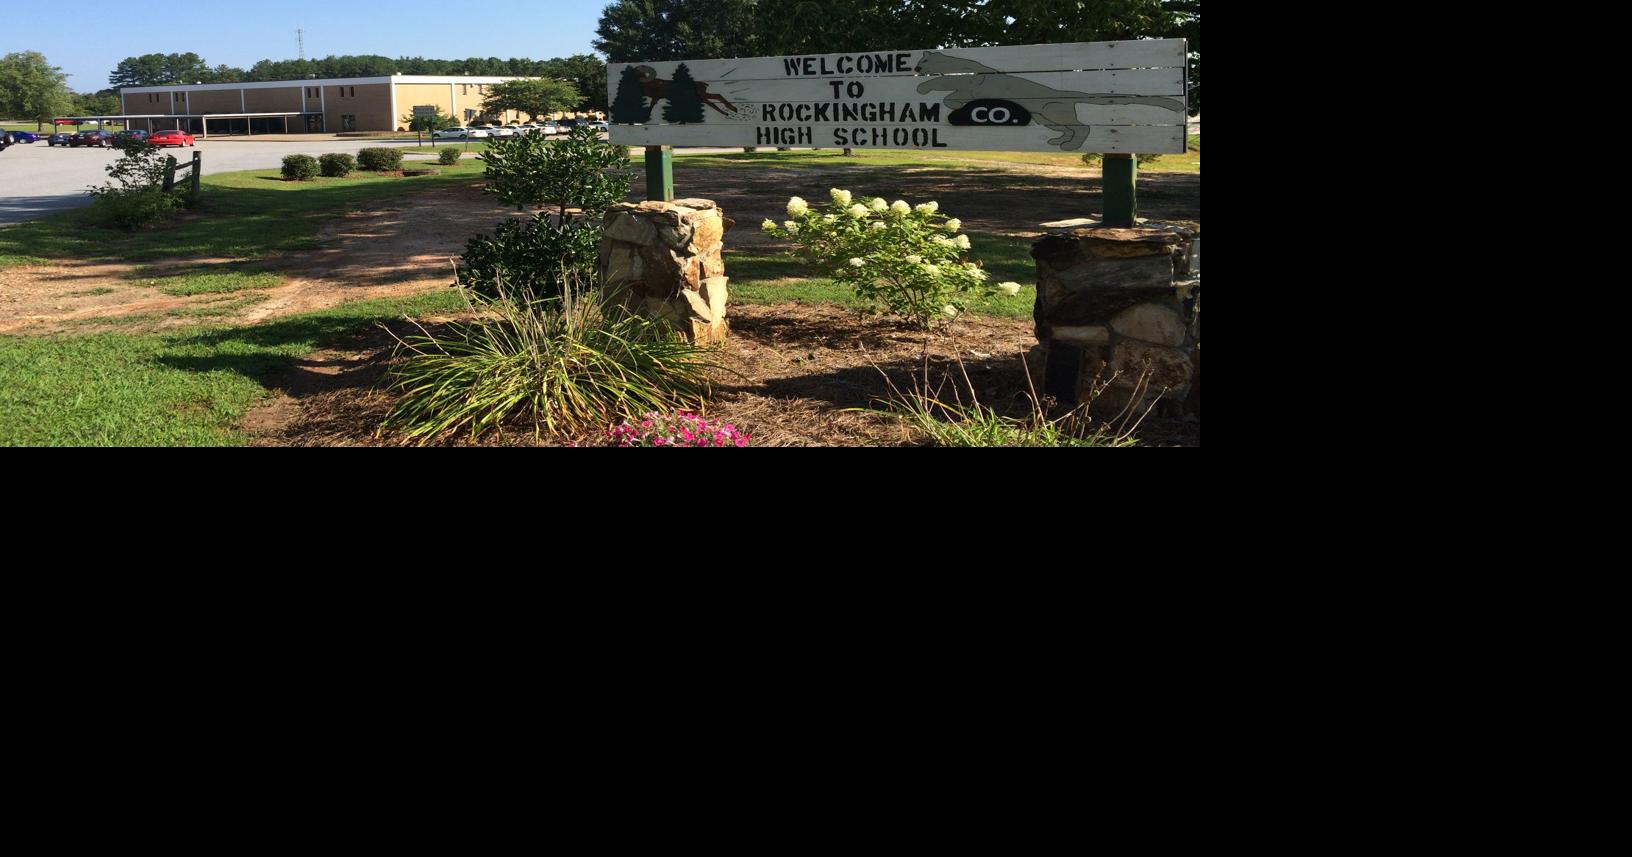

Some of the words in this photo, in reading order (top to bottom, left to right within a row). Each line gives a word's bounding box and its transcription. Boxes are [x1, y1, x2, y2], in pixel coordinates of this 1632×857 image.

[784, 53, 912, 76] WELCOME
[829, 80, 864, 99] TO
[762, 102, 940, 122] ROCKINGHAM
[970, 106, 1019, 124] CO.
[756, 126, 812, 145] HIGH
[833, 127, 948, 148] SCHOOL
